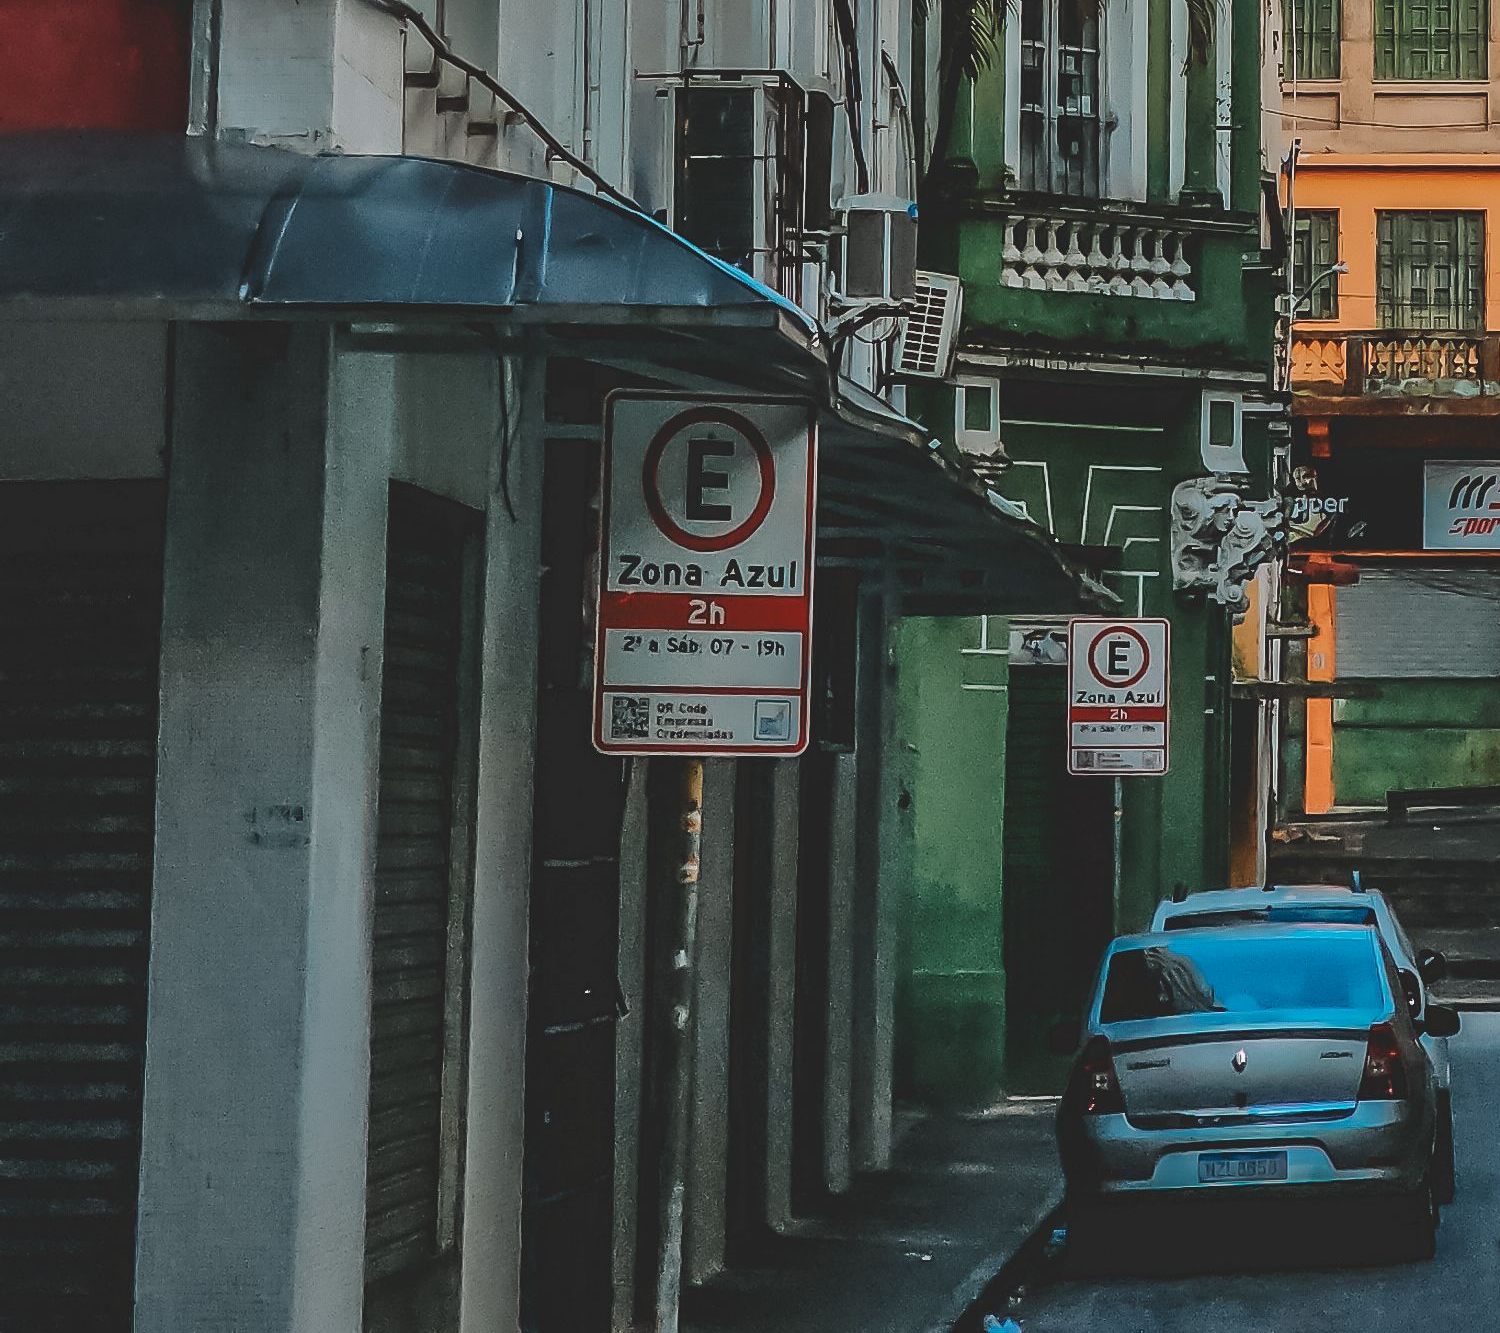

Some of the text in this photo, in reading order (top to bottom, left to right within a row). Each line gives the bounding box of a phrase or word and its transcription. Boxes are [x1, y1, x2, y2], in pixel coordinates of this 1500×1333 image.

[686, 439, 735, 521] E
[617, 555, 797, 589] Zona Azul
[687, 599, 725, 625] 2h
[649, 640, 659, 653] a
[711, 639, 734, 655] 07
[757, 639, 785, 657] 19h
[1109, 641, 1131, 676] E
[679, 703, 707, 714] Code
[1076, 691, 1161, 704] Zona Azul
[1110, 709, 1128, 720] 2h
